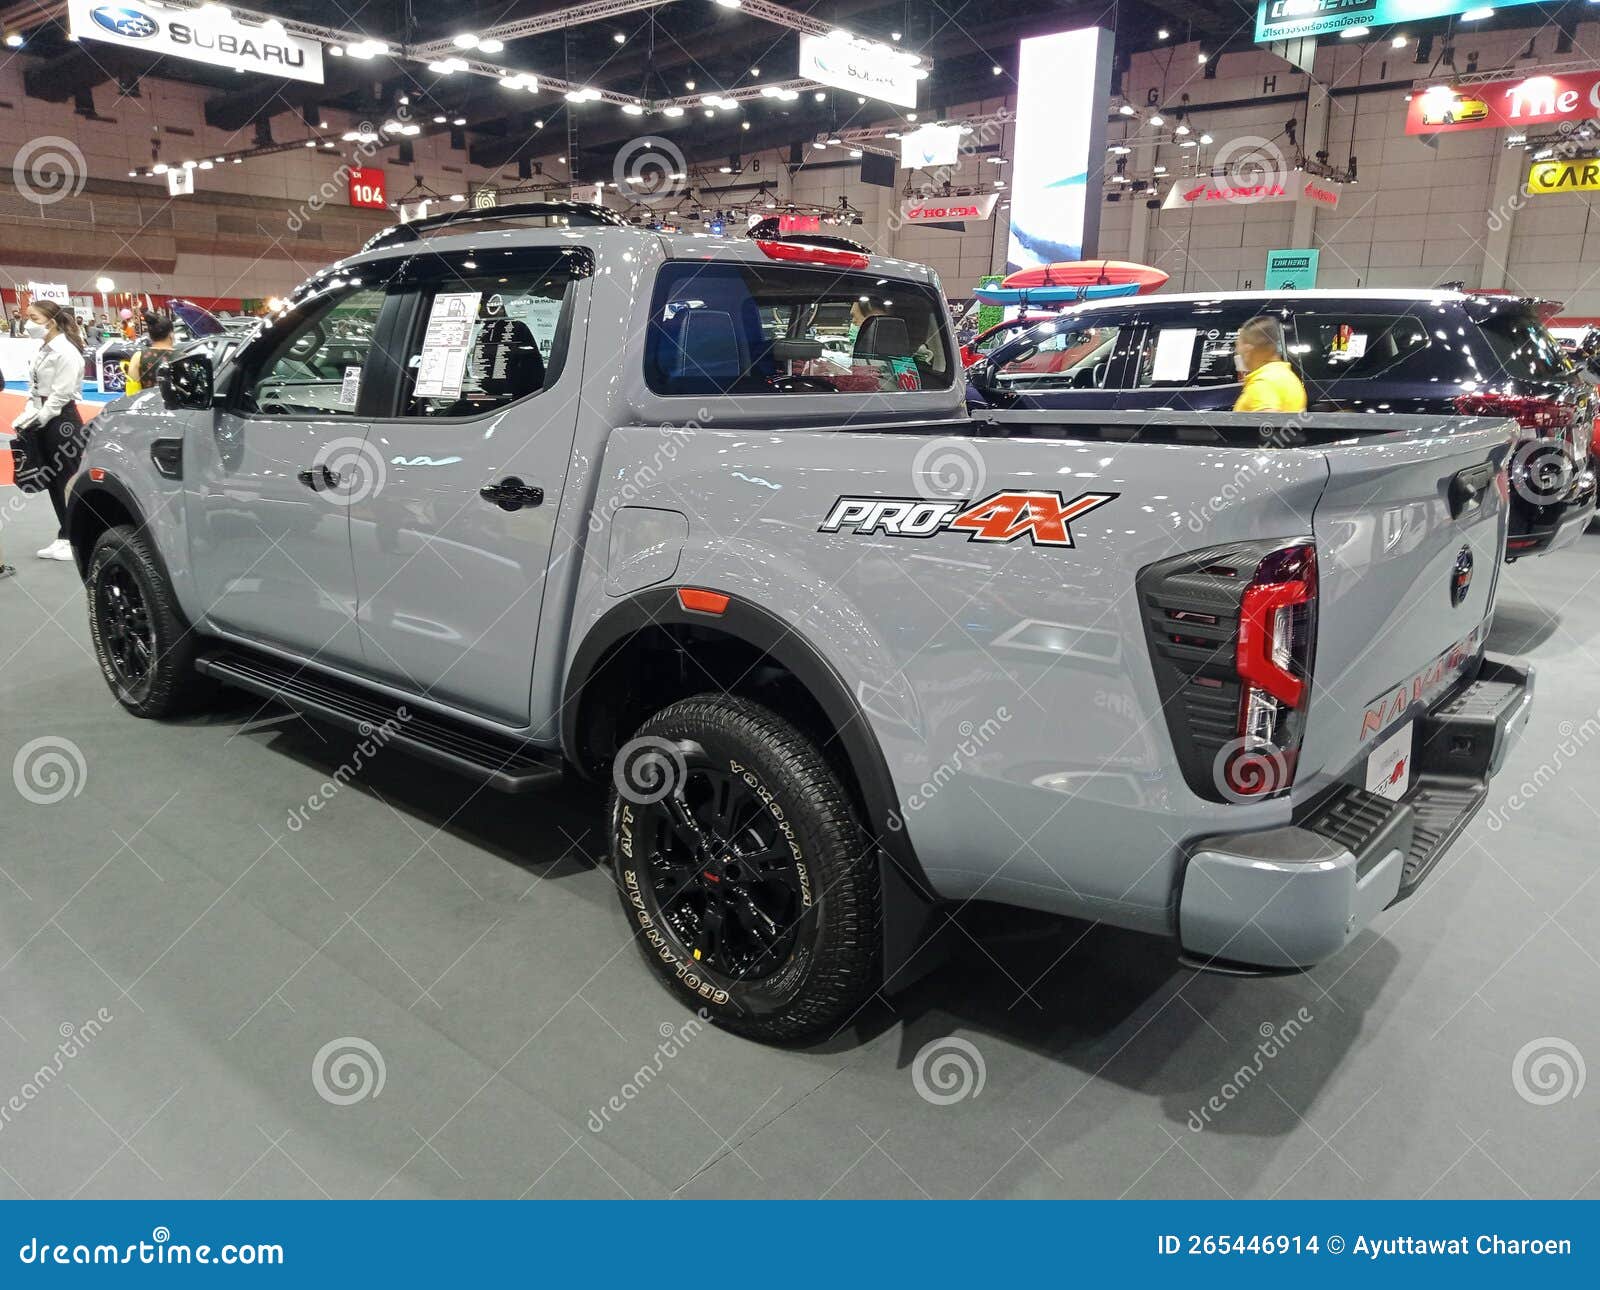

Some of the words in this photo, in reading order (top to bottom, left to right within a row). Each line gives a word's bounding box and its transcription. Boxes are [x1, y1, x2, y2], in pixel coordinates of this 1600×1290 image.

[168, 21, 304, 68] SUBARU
[1263, 76, 1277, 94] H
[1539, 165, 1600, 188] CAR
[354, 185, 384, 204] 104
[1206, 185, 1286, 201] HONDA
[923, 205, 979, 219] HONDA
[621, 804, 635, 858] A/T
[729, 759, 812, 907] YOKOHAMA
[624, 869, 729, 1005] GEOLANDAR
